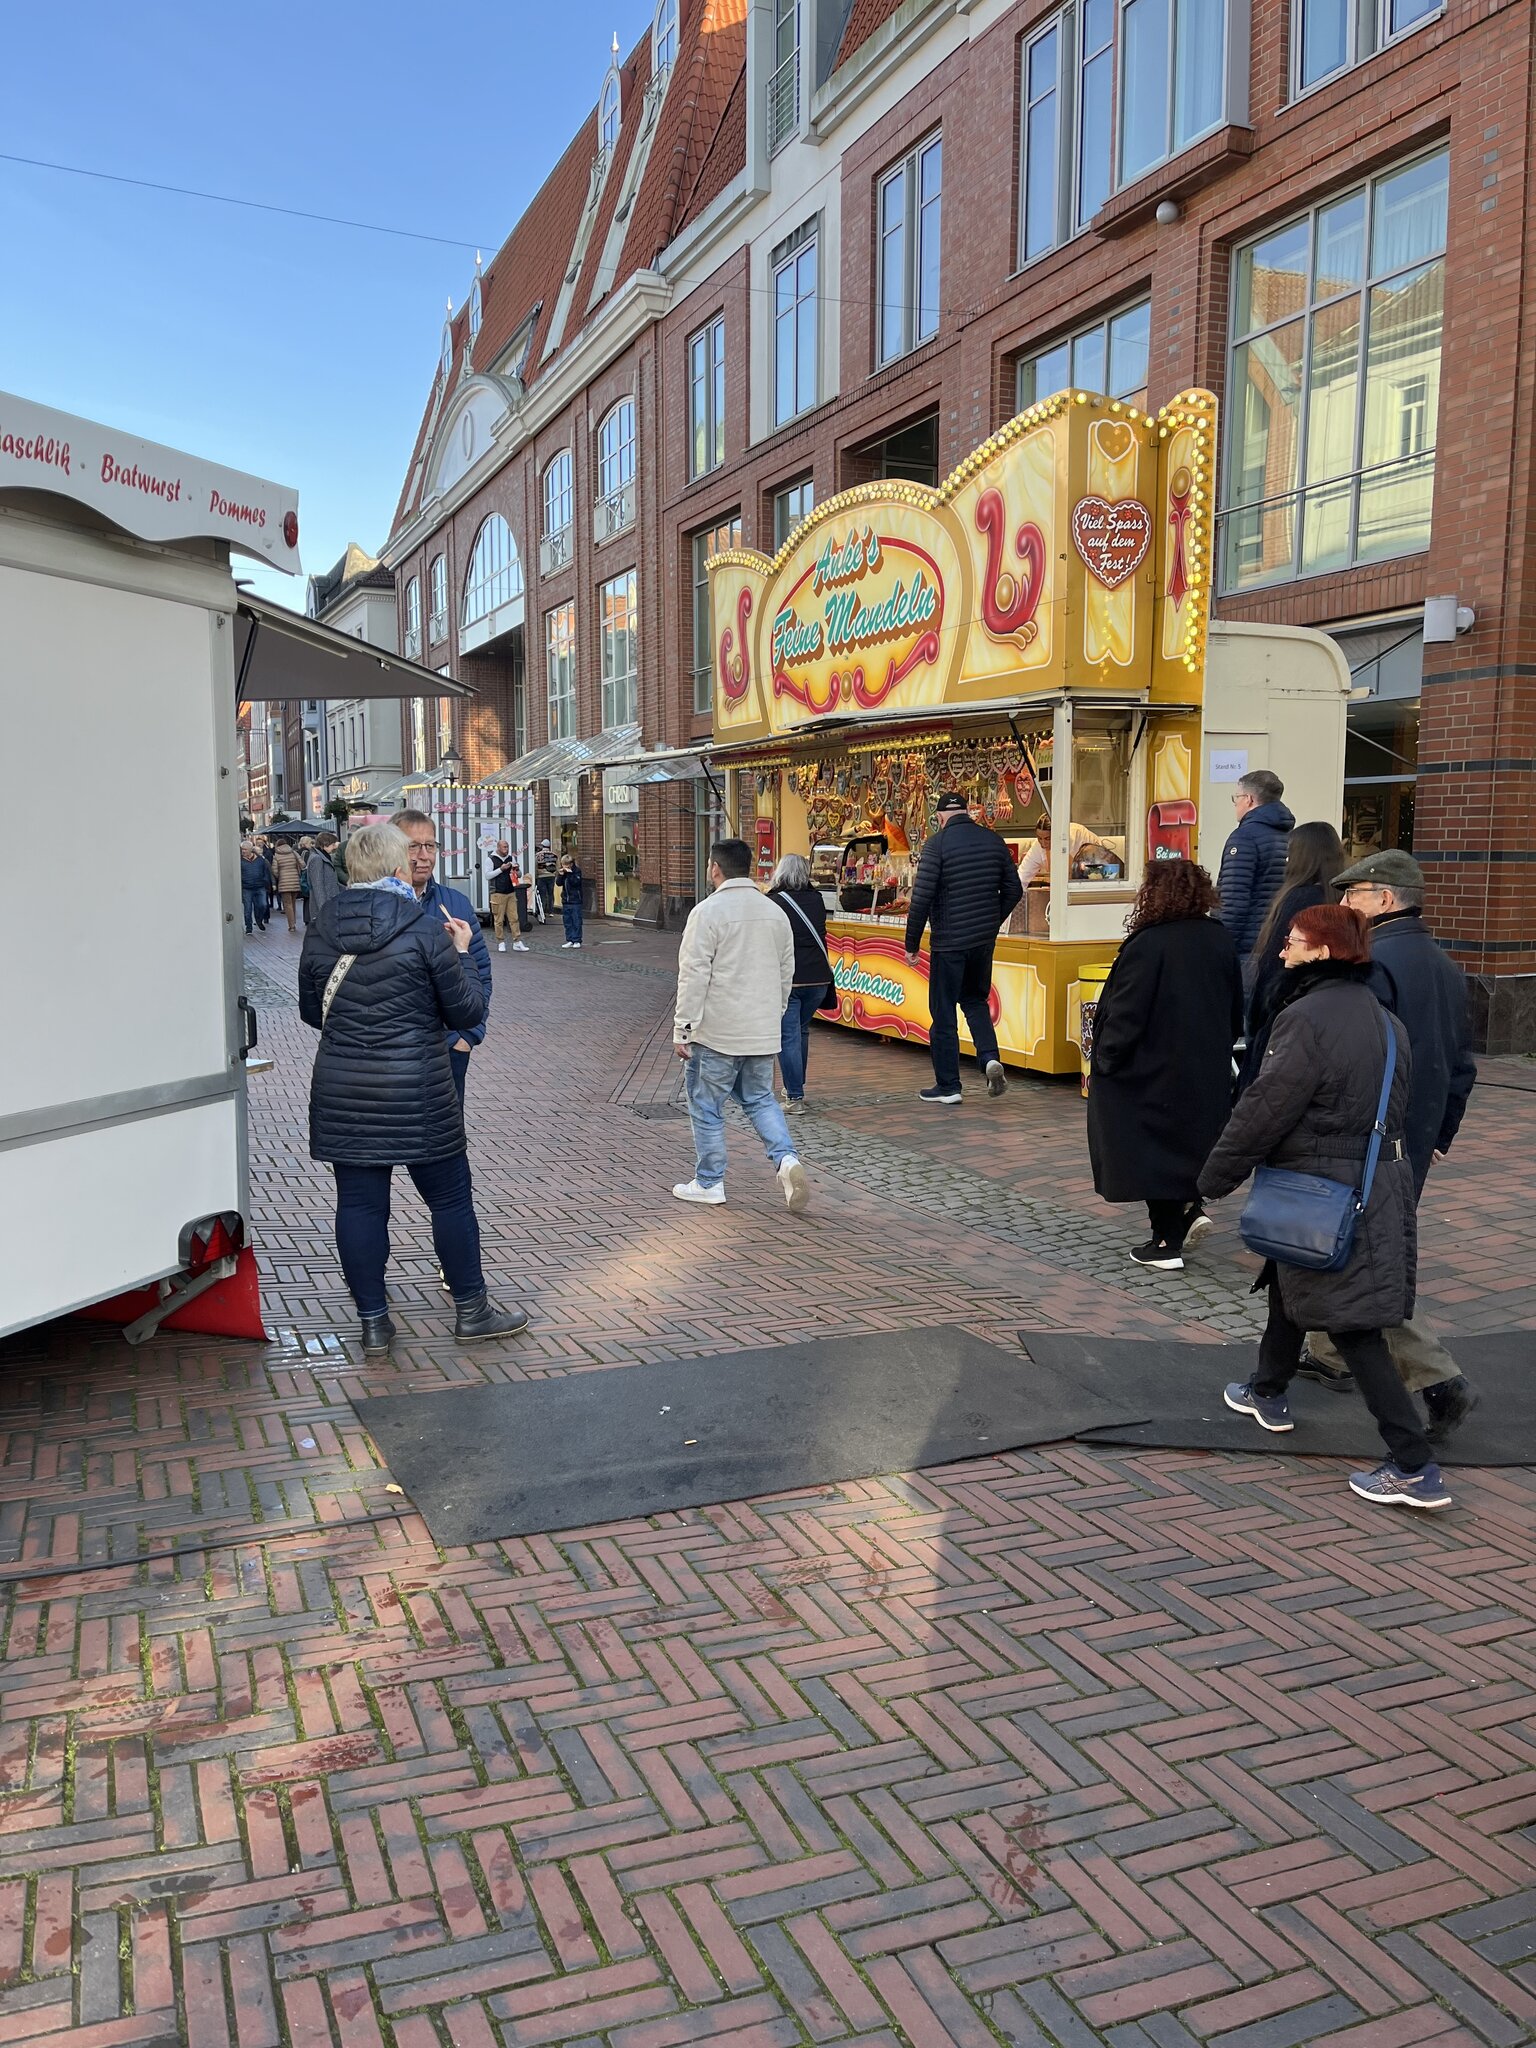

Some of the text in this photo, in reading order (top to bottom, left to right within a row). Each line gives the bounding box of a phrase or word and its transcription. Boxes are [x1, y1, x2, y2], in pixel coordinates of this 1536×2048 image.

[100, 453, 181, 503] Bratwurst
[209, 490, 266, 528] Pommes
[1080, 513, 1143, 533] Viel Spass
[812, 525, 879, 590] Anke's
[1087, 532, 1135, 552] auf dem
[1100, 553, 1131, 571] Fest!
[773, 569, 935, 667] Feine Mandeln
[1155, 846, 1169, 860] Bei
[831, 956, 905, 1006] kelmann
